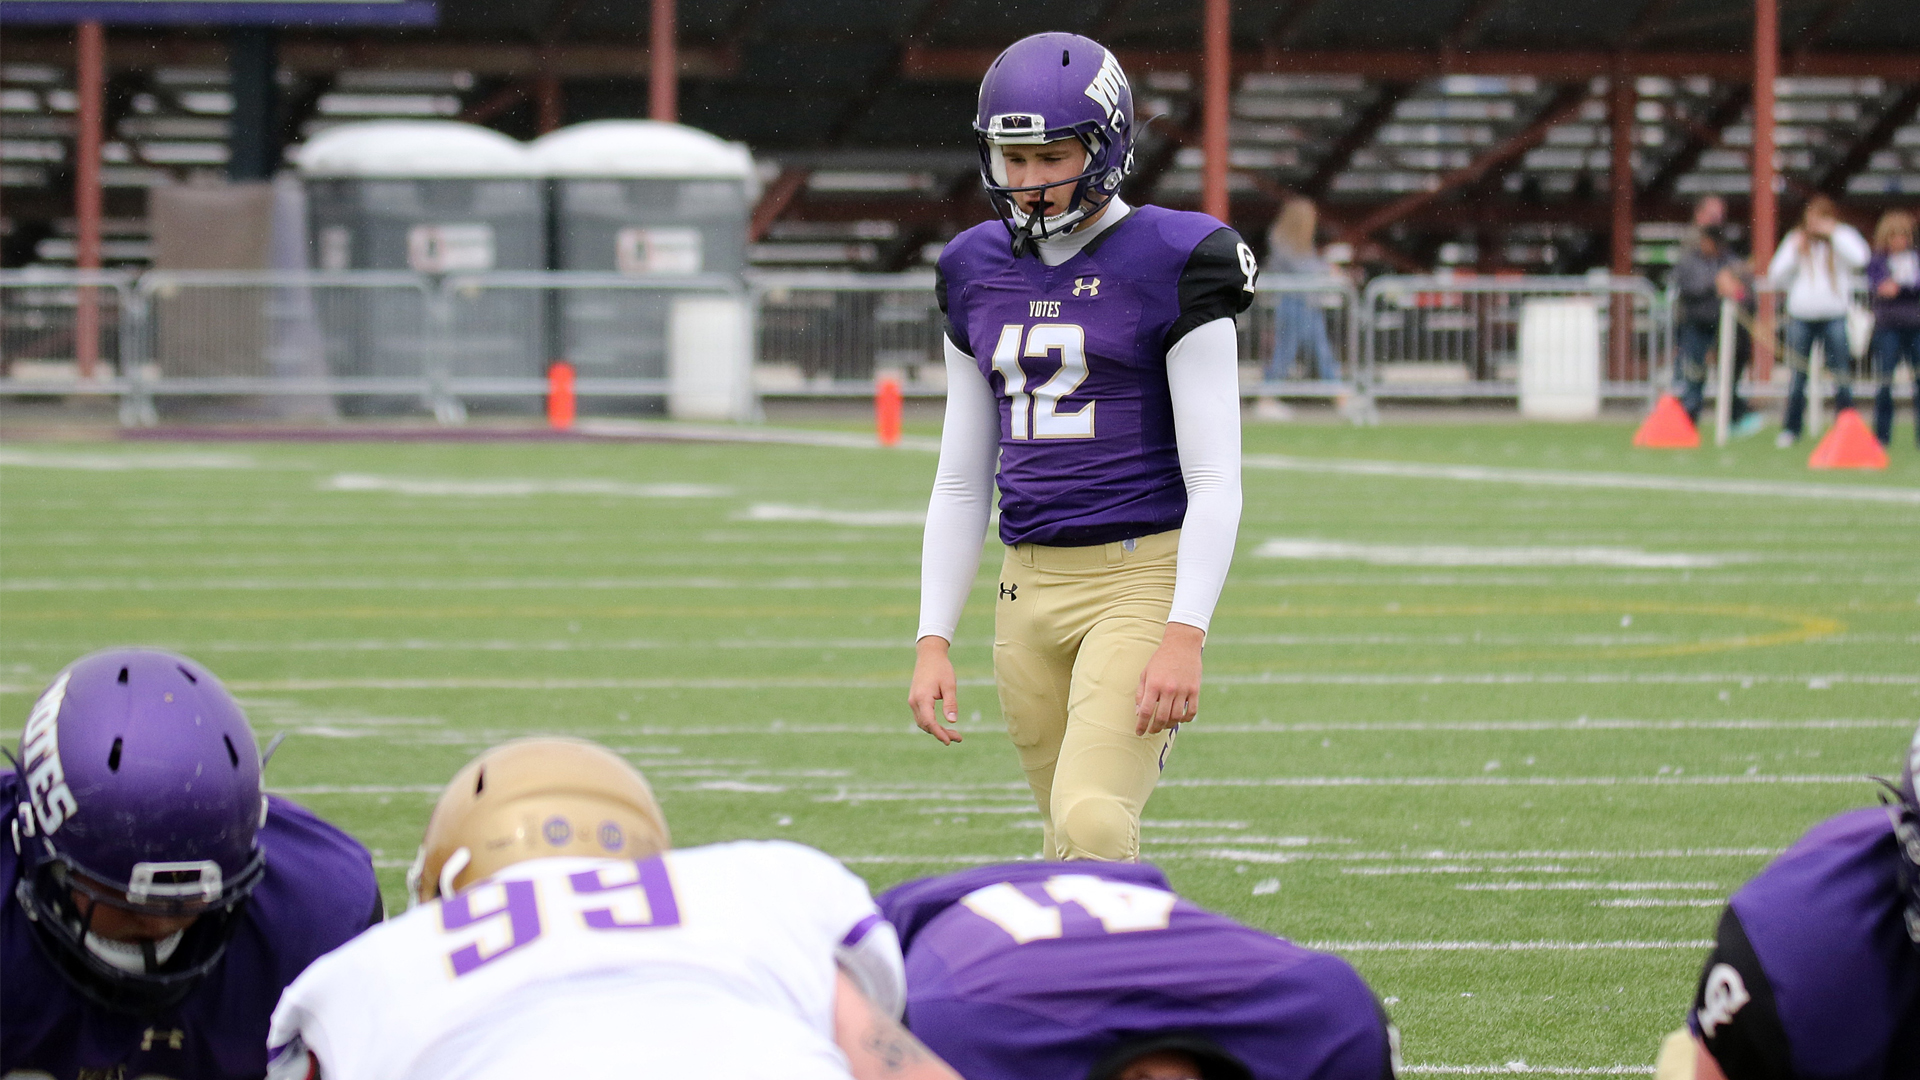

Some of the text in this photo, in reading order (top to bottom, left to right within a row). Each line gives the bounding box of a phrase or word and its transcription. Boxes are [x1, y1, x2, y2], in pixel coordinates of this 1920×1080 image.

[1029, 301, 1062, 318] YOTES
[991, 323, 1096, 441] 12
[436, 856, 688, 976] 99
